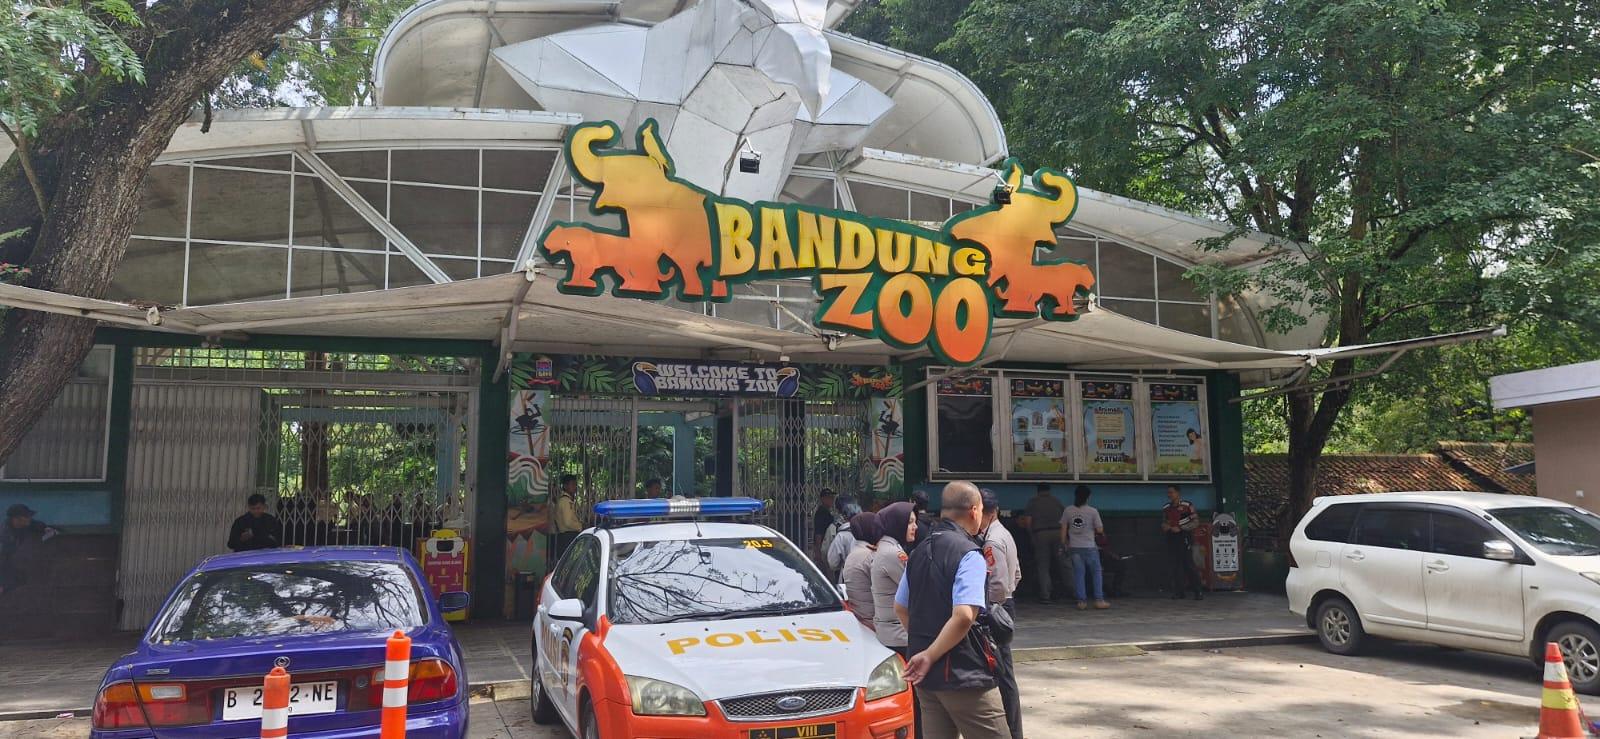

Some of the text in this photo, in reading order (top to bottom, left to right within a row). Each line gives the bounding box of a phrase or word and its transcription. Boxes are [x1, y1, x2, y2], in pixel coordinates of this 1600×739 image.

[714, 202, 986, 277] BANDUNG
[820, 272, 989, 363] ZOO
[657, 364, 778, 380] WELCOME TO
[655, 376, 778, 392] BANDUNG ZOO
[743, 539, 773, 550] 20.5
[667, 628, 851, 655] POLISI
[227, 683, 334, 708] B 22 NE
[797, 725, 818, 737] VIII
